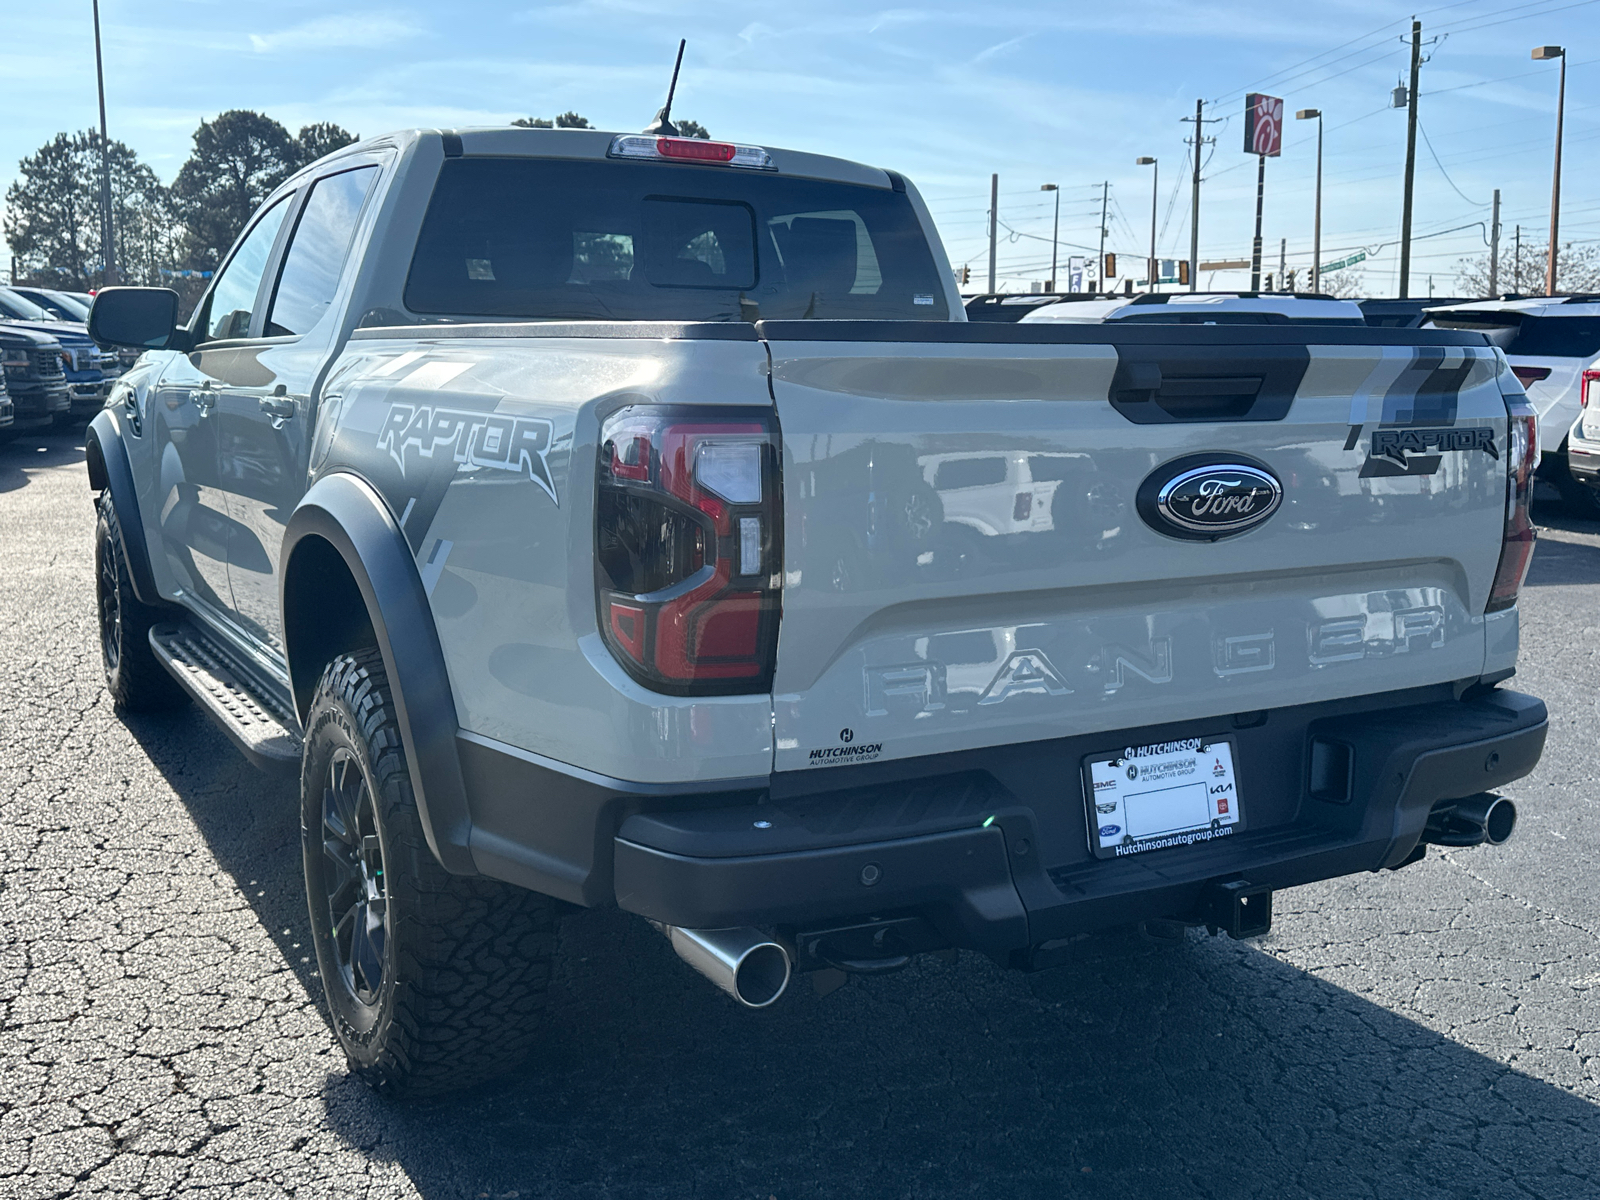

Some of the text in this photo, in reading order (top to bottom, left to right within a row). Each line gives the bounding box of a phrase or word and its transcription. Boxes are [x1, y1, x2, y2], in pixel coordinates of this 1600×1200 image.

[376, 402, 560, 509] RAPTOR
[1371, 427, 1499, 470] RAPTOR
[1191, 479, 1257, 517] Ford
[863, 605, 1445, 717] RANGER
[809, 743, 883, 759] HUTCHINSON
[1137, 738, 1201, 758] HUTCHINSON
[810, 753, 879, 766] AUTOMOTIVE GROUP
[1140, 758, 1197, 776] HUTCHINSON
[1094, 780, 1117, 789] GMC
[1142, 767, 1196, 782] AUTOMOTIVE GROUP
[1115, 826, 1233, 856] Hutchinsonautogroup.com
